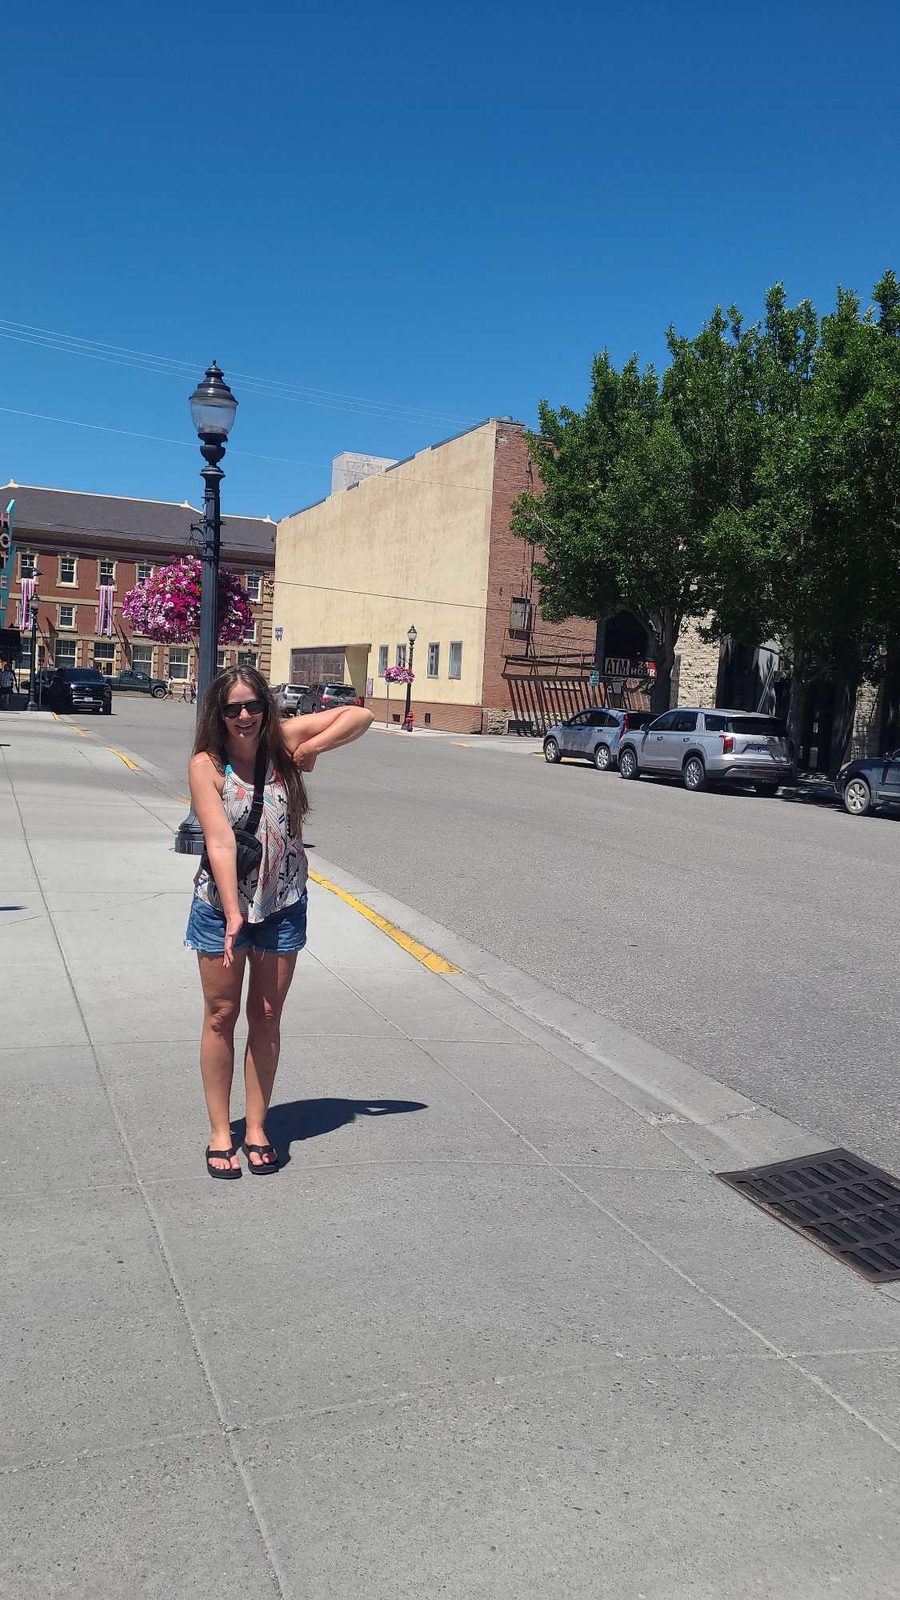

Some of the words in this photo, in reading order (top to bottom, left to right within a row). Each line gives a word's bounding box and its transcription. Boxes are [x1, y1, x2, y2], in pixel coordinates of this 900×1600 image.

[0, 512, 11, 609] HOTEL
[606, 658, 629, 675] ATM
[631, 667, 656, 677] HOUR
